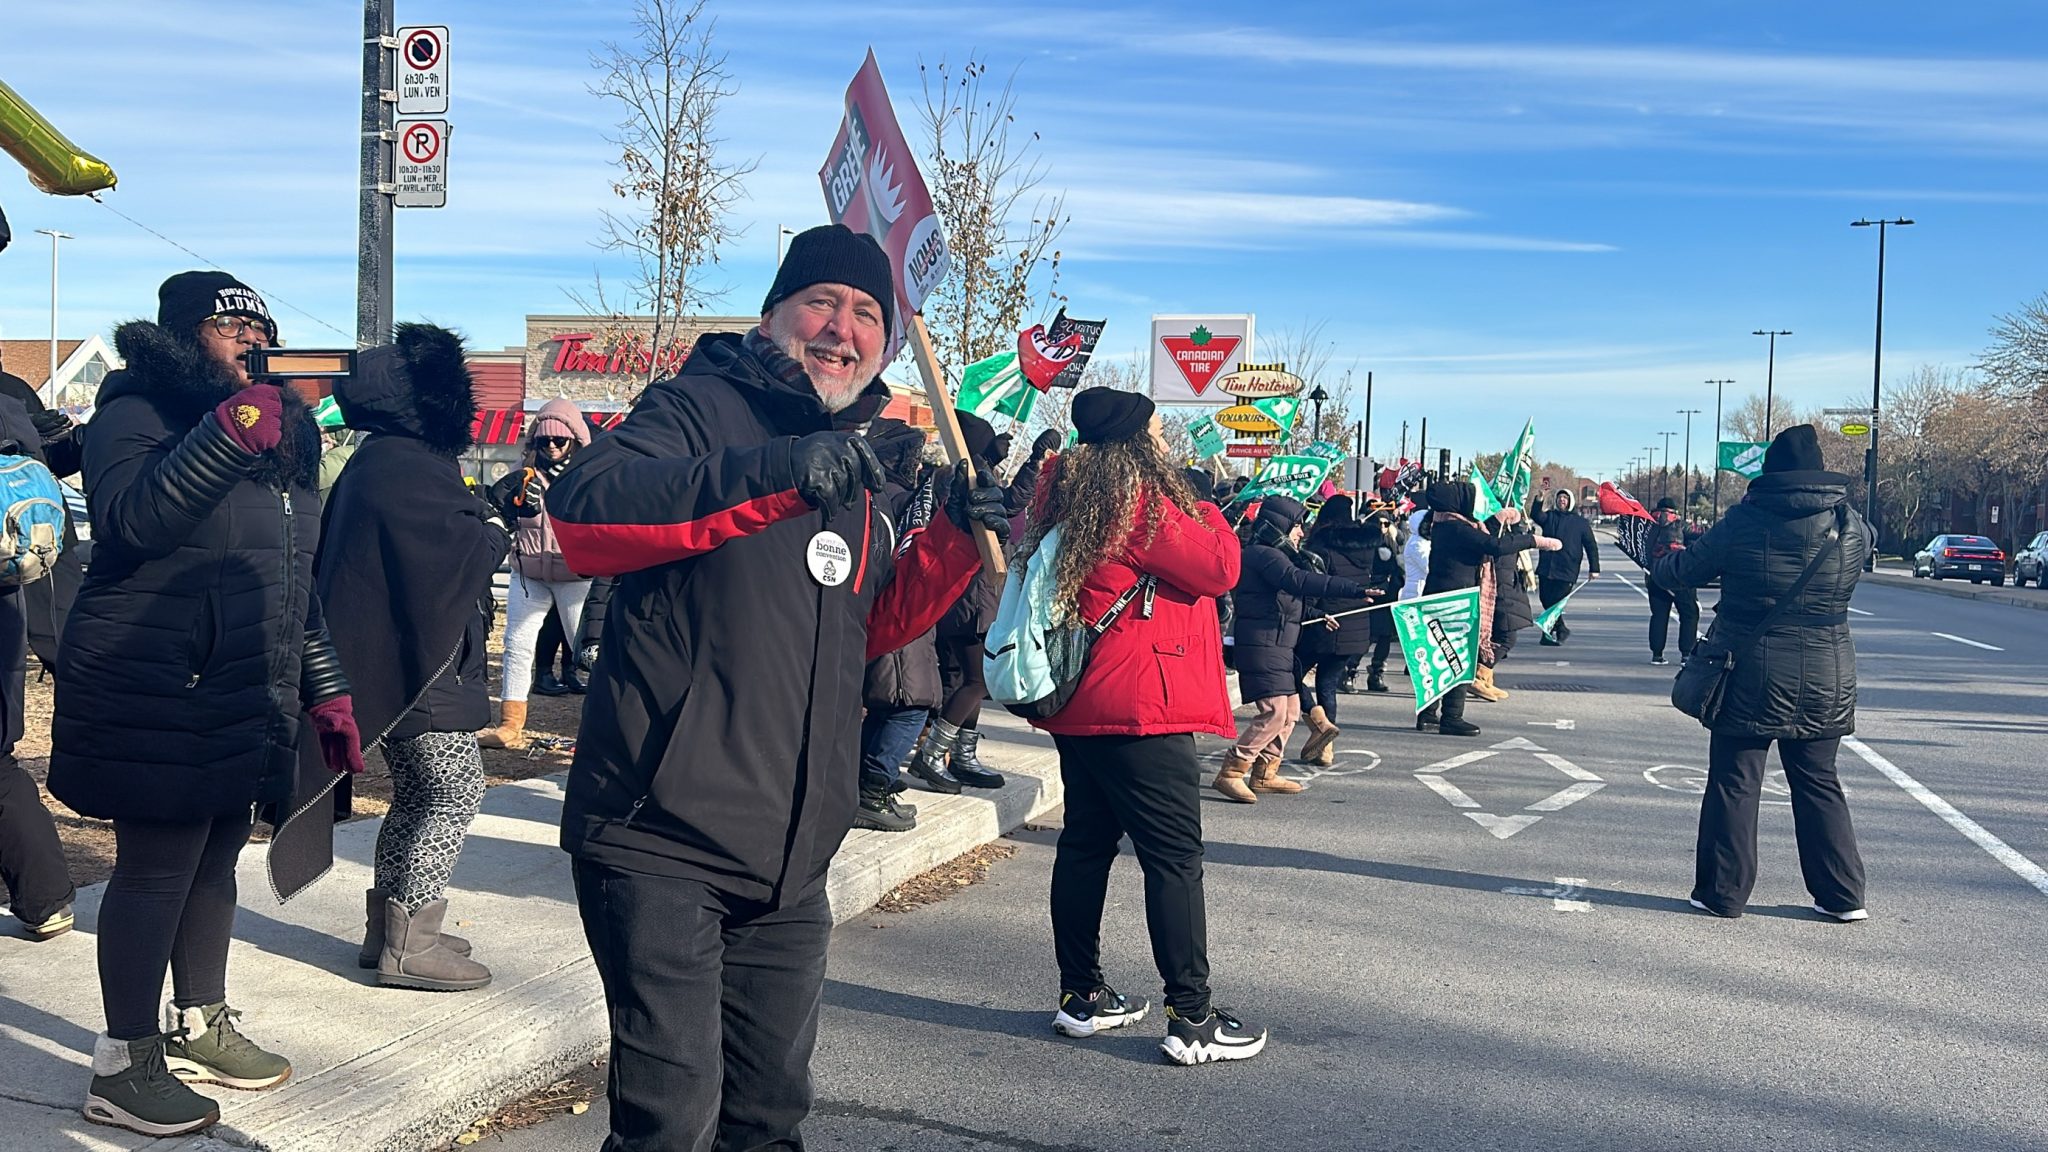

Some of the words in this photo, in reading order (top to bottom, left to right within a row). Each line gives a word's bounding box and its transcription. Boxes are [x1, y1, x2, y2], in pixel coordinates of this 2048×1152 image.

[404, 87, 419, 98] LUN
[425, 86, 440, 97] VEN
[824, 162, 833, 186] EN
[908, 229, 943, 288] NOUS
[551, 332, 608, 373] Tim
[1177, 350, 1224, 361] CANADIAN
[1190, 362, 1210, 373] TIRE
[1224, 376, 1246, 392] Tim
[1247, 375, 1295, 392] Hortons
[816, 539, 846, 555] bonne
[823, 575, 836, 583] CSN
[1111, 597, 1128, 615] PINK
